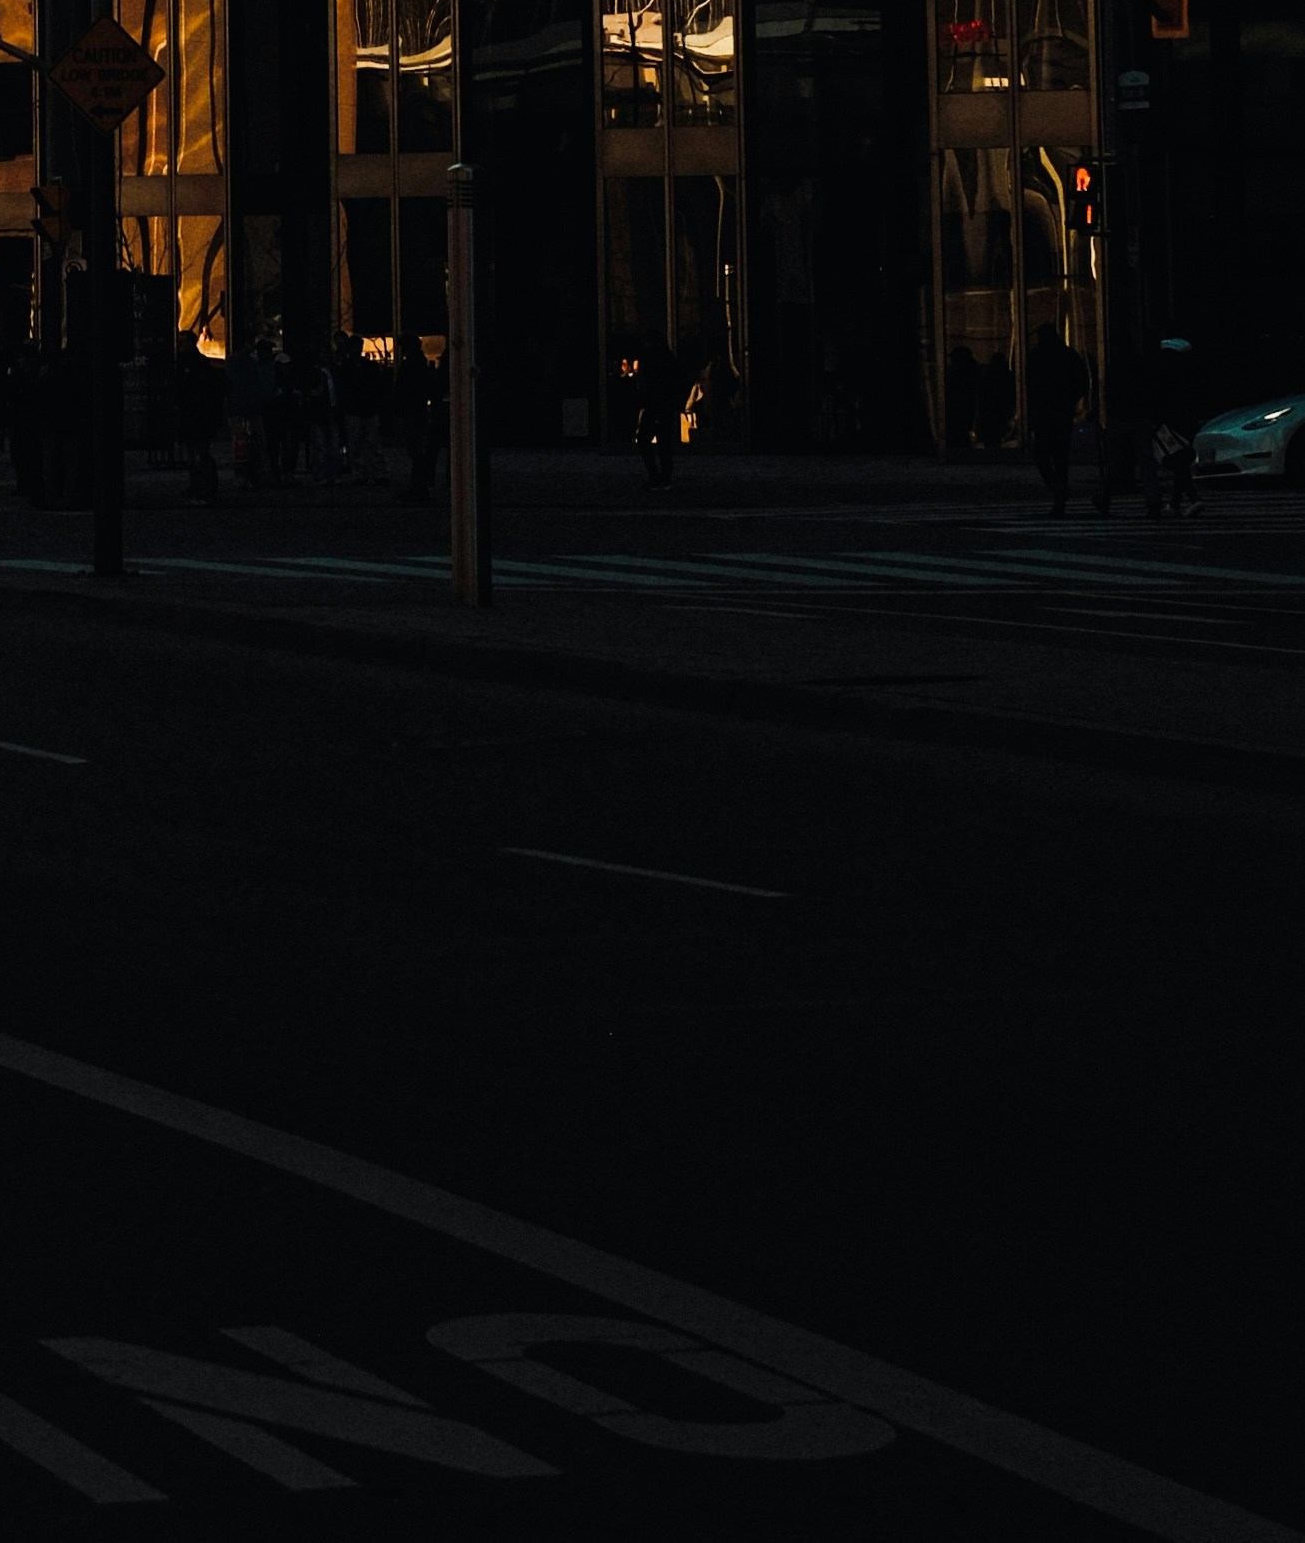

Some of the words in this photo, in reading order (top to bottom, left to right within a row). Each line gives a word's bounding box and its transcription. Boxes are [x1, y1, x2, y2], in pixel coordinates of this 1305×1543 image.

[72, 47, 137, 64] CAUTION
[60, 68, 91, 82] LOW
[98, 68, 149, 82] BRIDGE
